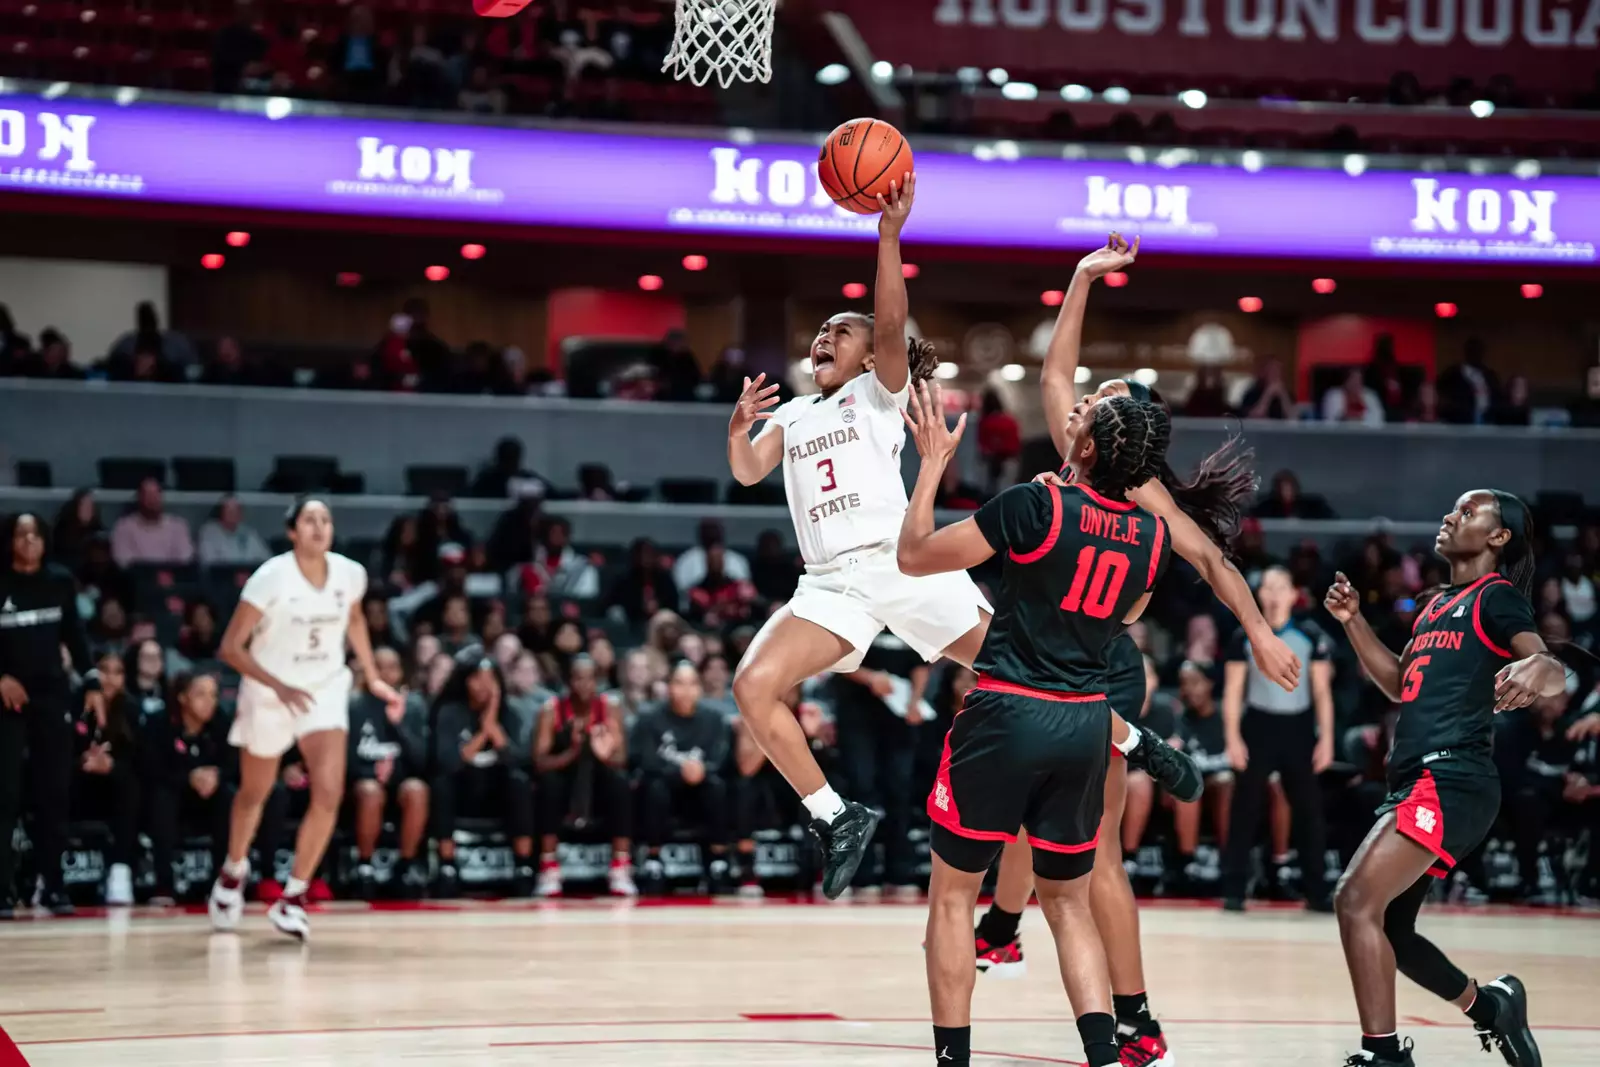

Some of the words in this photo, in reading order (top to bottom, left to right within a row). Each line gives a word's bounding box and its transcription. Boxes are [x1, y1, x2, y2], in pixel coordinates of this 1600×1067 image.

[788, 426, 860, 463] FLORIDA
[816, 458, 838, 492] 3
[809, 493, 861, 523] STATE
[1079, 504, 1142, 546] ONYEJE
[1060, 545, 1131, 619] 10
